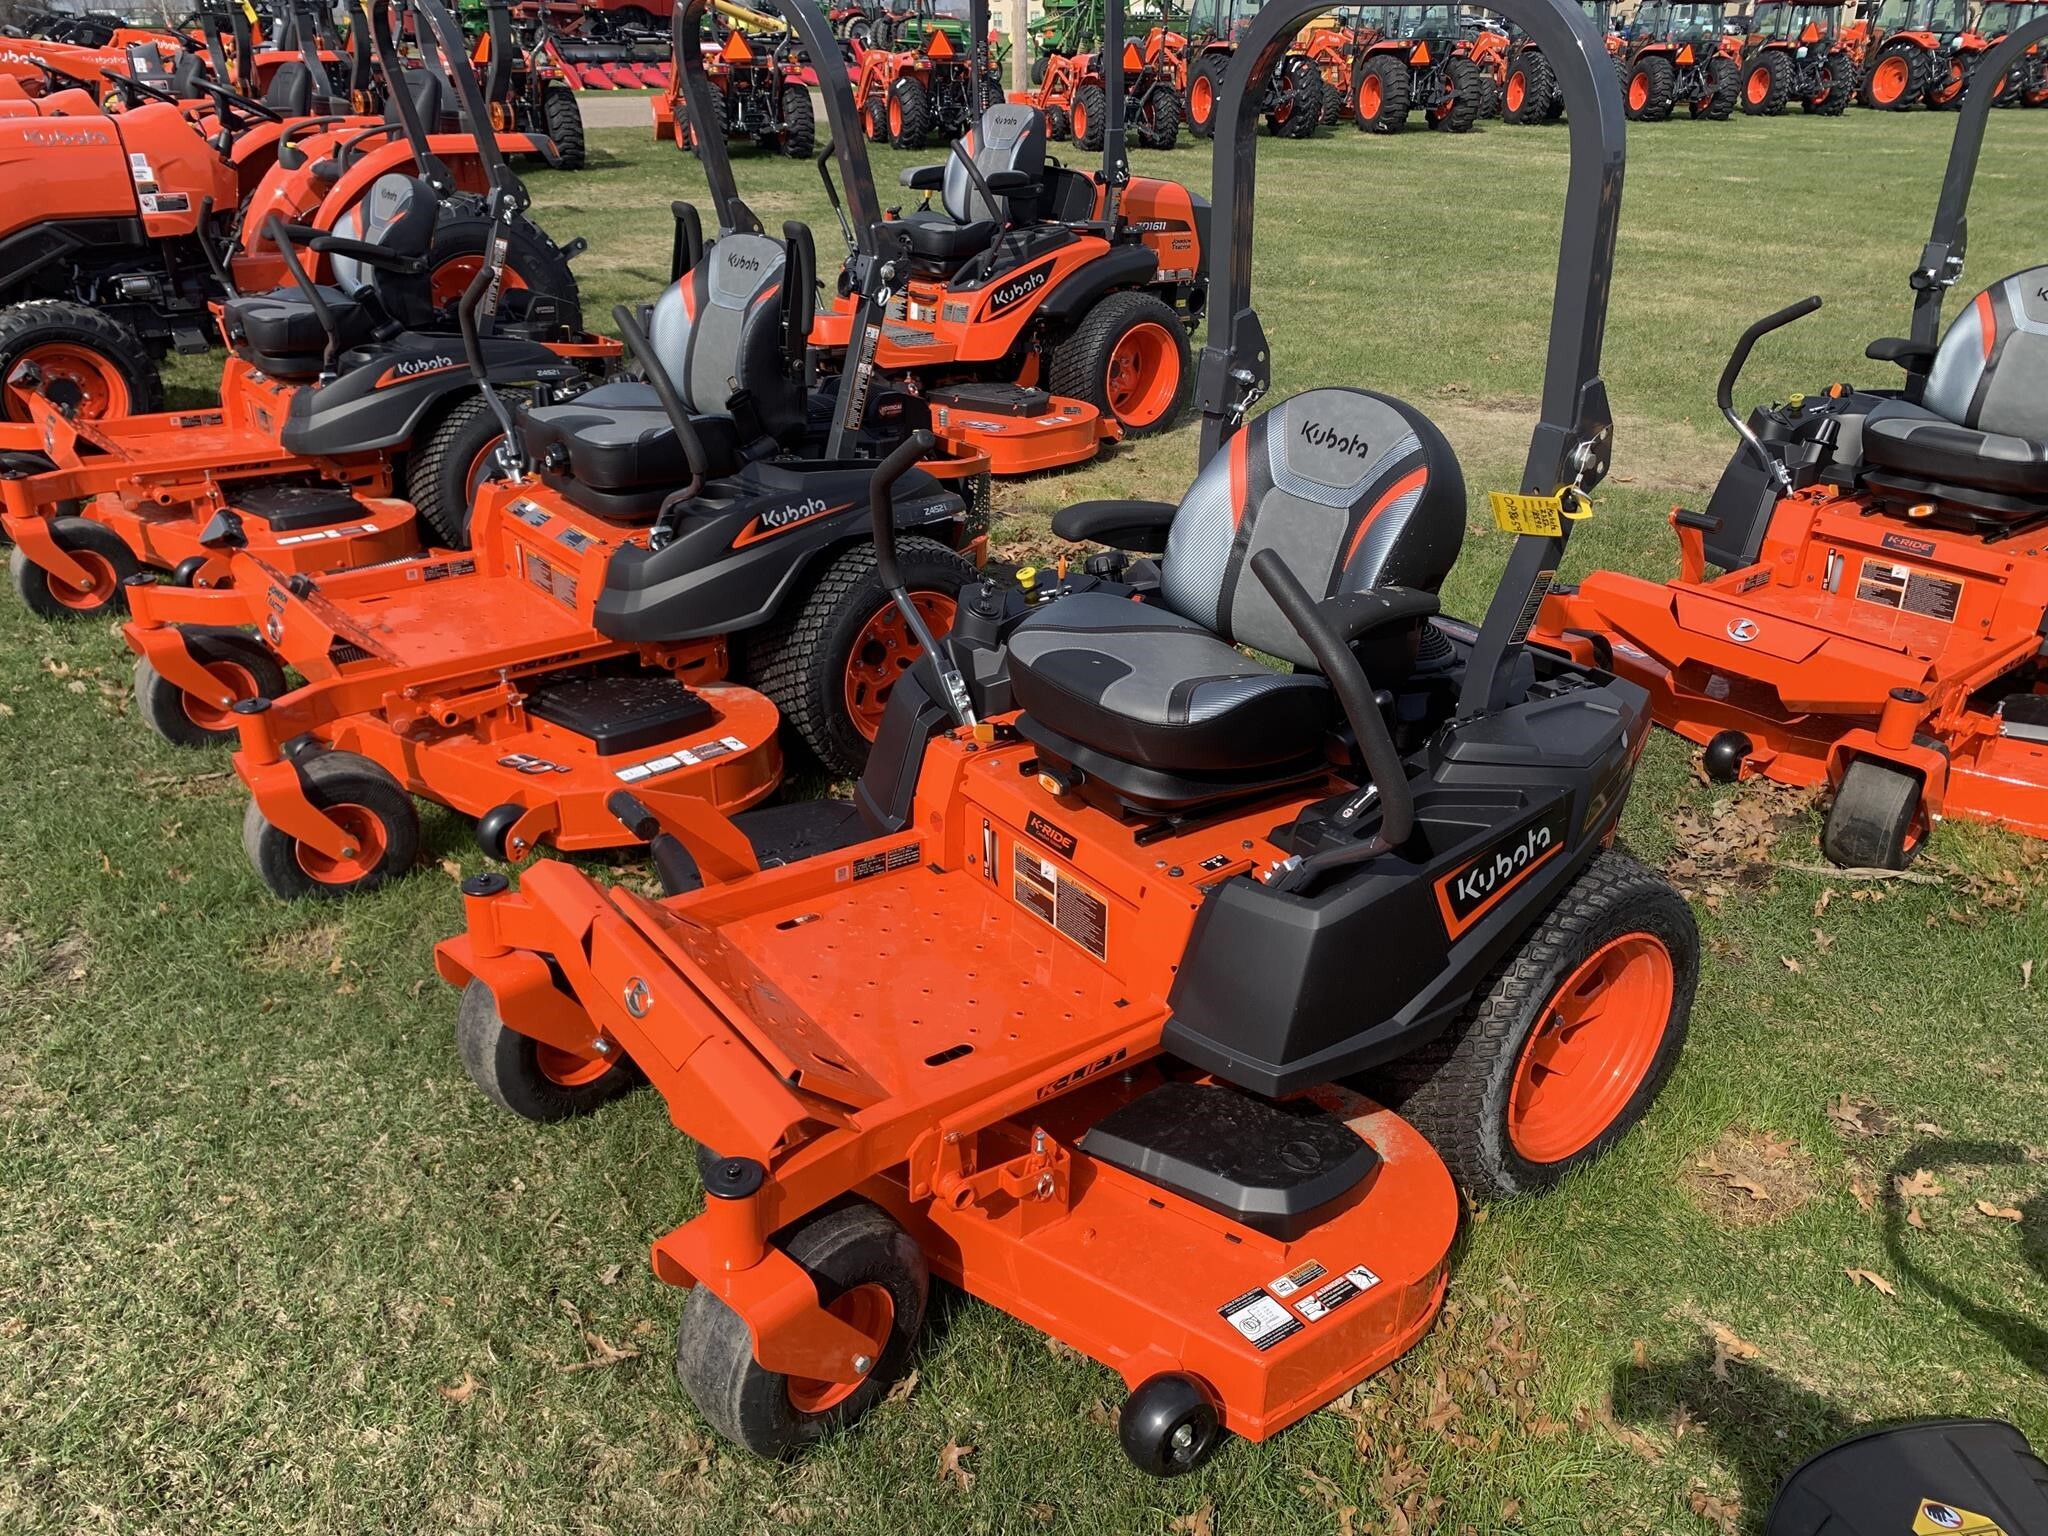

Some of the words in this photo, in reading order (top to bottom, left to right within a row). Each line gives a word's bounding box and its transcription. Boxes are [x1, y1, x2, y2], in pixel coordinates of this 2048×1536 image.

[0, 50, 46, 65] ubota
[995, 116, 1017, 126] Kubota
[23, 128, 109, 145] Kubota
[728, 252, 760, 272] Kubota
[993, 272, 1045, 305] Kubota
[398, 354, 453, 375] Kubota
[1300, 420, 1369, 459] Kubota
[761, 498, 827, 527] Kubota
[1887, 535, 1930, 551] K-RIDE
[1031, 817, 1073, 849] K-RIDE
[1457, 826, 1551, 901] Kubota
[1040, 1047, 1126, 1098] K-LIFT
[1320, 1276, 1346, 1295] DANGER
